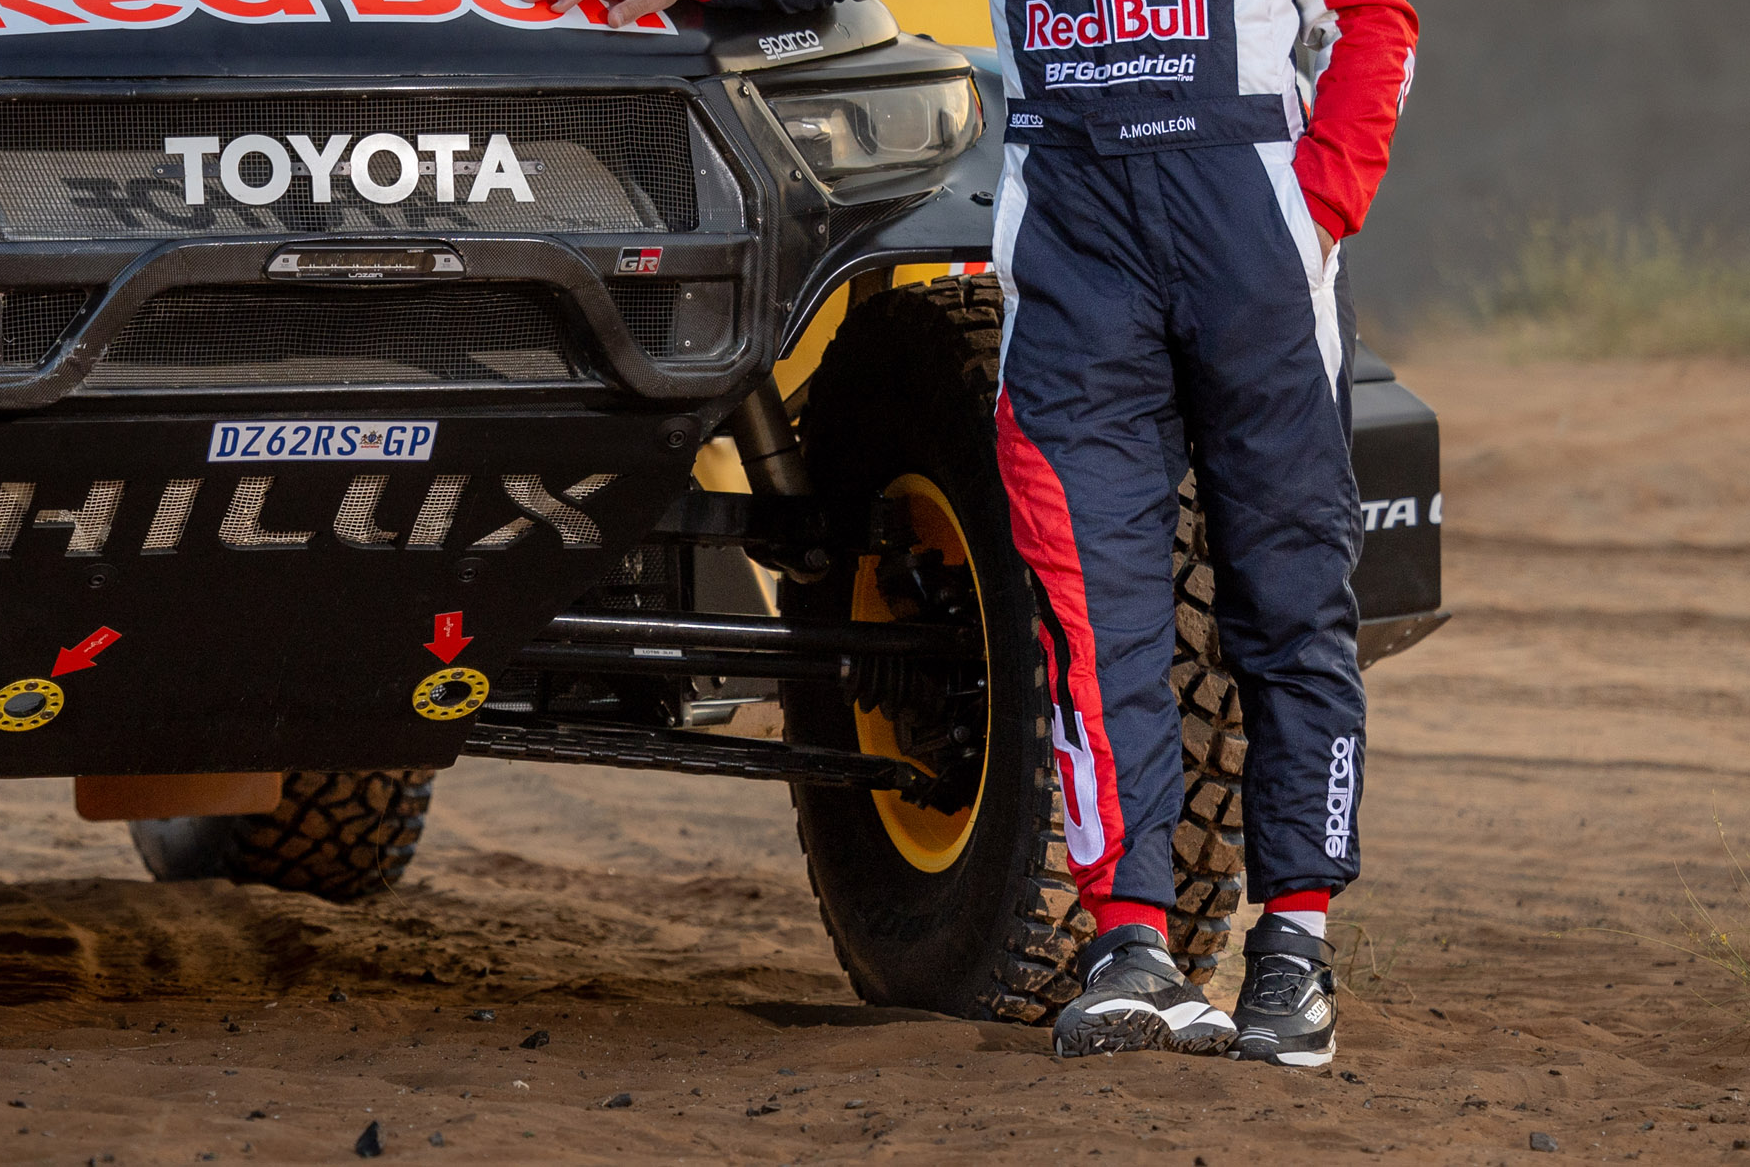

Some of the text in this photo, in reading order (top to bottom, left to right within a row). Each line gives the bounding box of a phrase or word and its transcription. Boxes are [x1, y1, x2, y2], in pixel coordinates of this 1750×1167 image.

[758, 29, 824, 60] sparco
[1046, 54, 1196, 83] BFGoodrich
[1009, 113, 1044, 128] sparco
[1119, 115, 1197, 139] A.MONLEÓN
[164, 134, 536, 205] TOYOTA
[216, 425, 431, 457] DZ62RS GP
[1325, 736, 1355, 859] sparco
